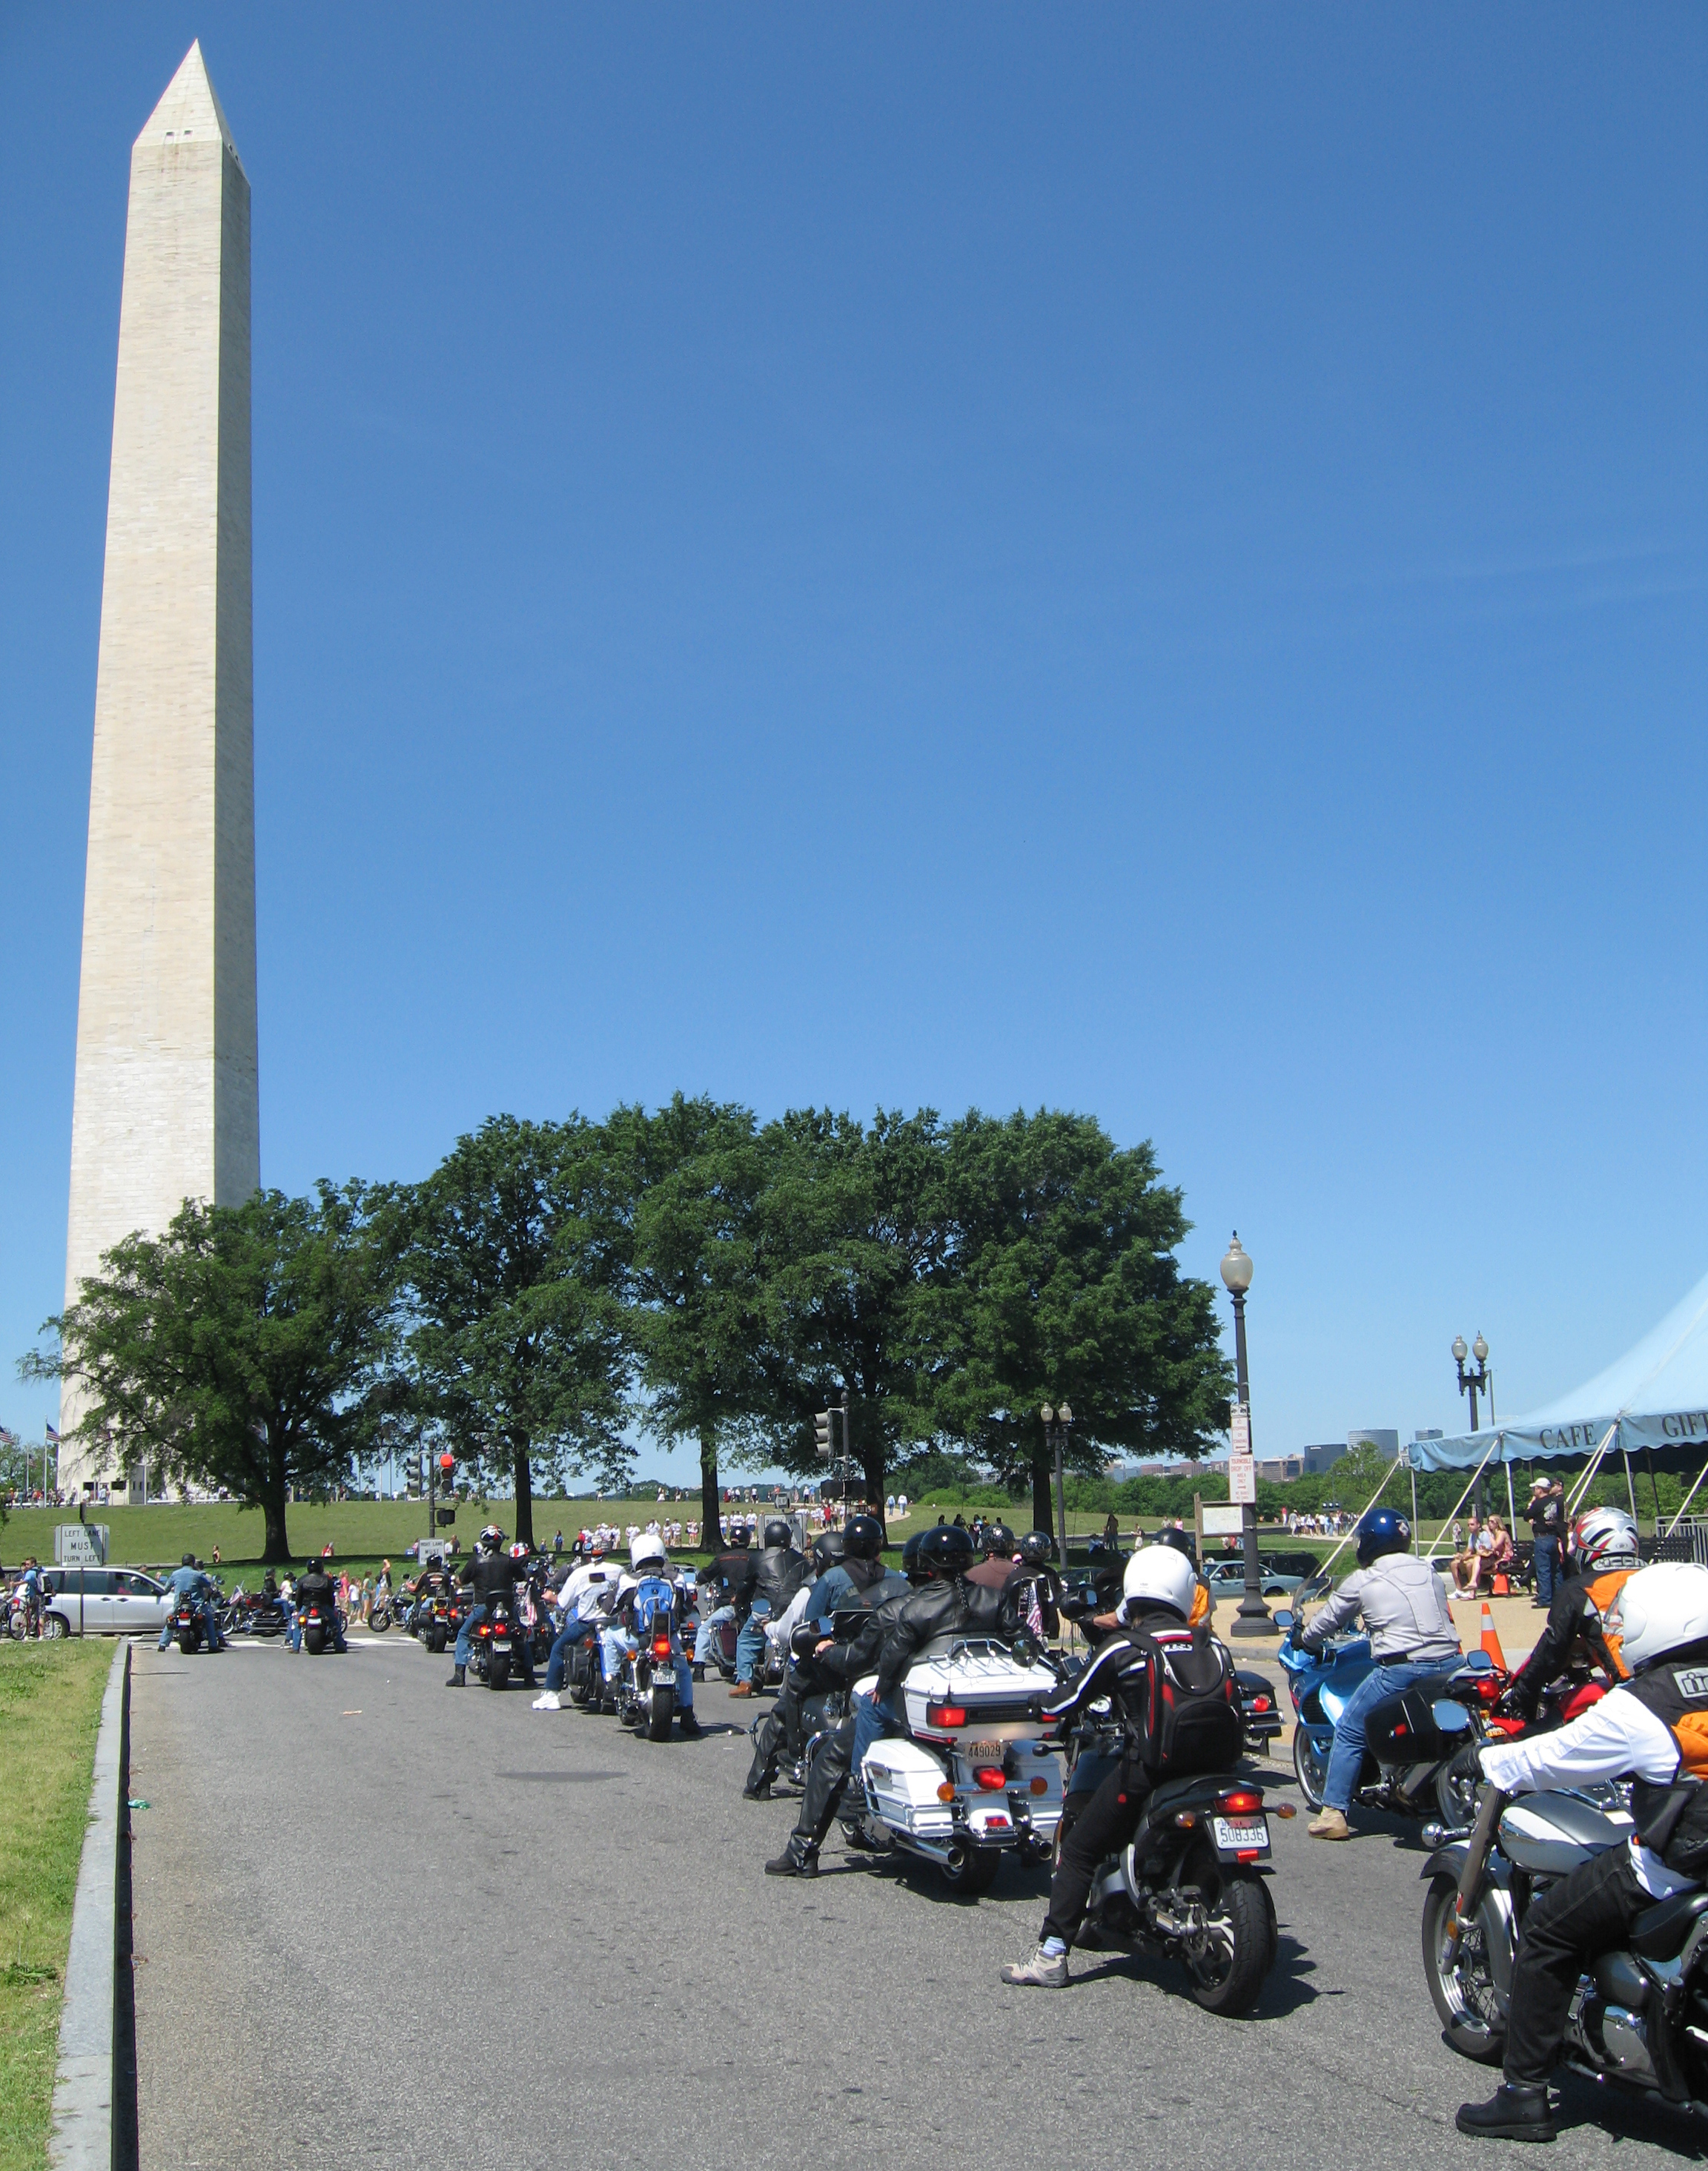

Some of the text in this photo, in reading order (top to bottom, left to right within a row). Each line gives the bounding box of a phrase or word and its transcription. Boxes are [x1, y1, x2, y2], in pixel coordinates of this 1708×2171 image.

[1539, 1424, 1597, 1450] CAFE
[968, 1745, 1001, 1757] 449029
[1219, 1826, 1264, 1843] 508336
